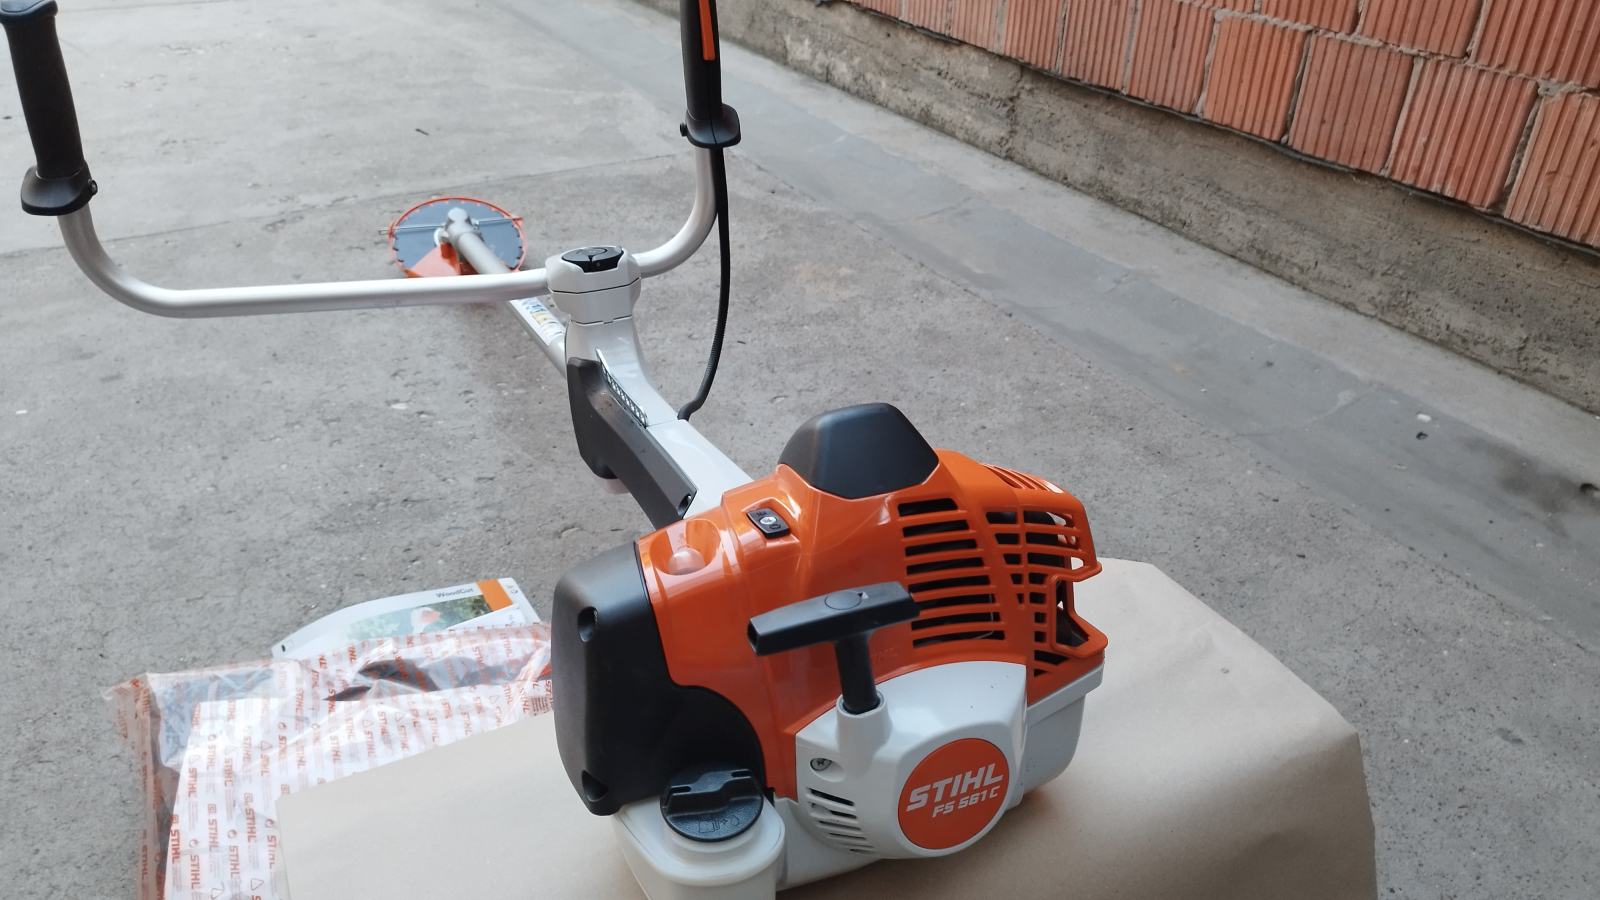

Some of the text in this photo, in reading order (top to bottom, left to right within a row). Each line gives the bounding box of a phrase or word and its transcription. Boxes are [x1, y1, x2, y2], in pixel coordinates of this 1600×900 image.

[503, 683, 514, 705] STIHL
[206, 744, 216, 771] STIHL
[330, 735, 341, 764] STIHL
[364, 730, 376, 757] STIHL
[187, 768, 198, 798] STIHL
[224, 757, 233, 787] STIHL
[906, 763, 1004, 812] STIHL
[932, 801, 956, 818] FS
[958, 790, 987, 809] 561
[208, 819, 219, 852] STIHL
[245, 808, 257, 843] STIHL
[171, 829, 181, 864] STIHL
[267, 834, 277, 870] STIHL
[190, 854, 200, 890] STIHL
[229, 845, 240, 880] STIHL
